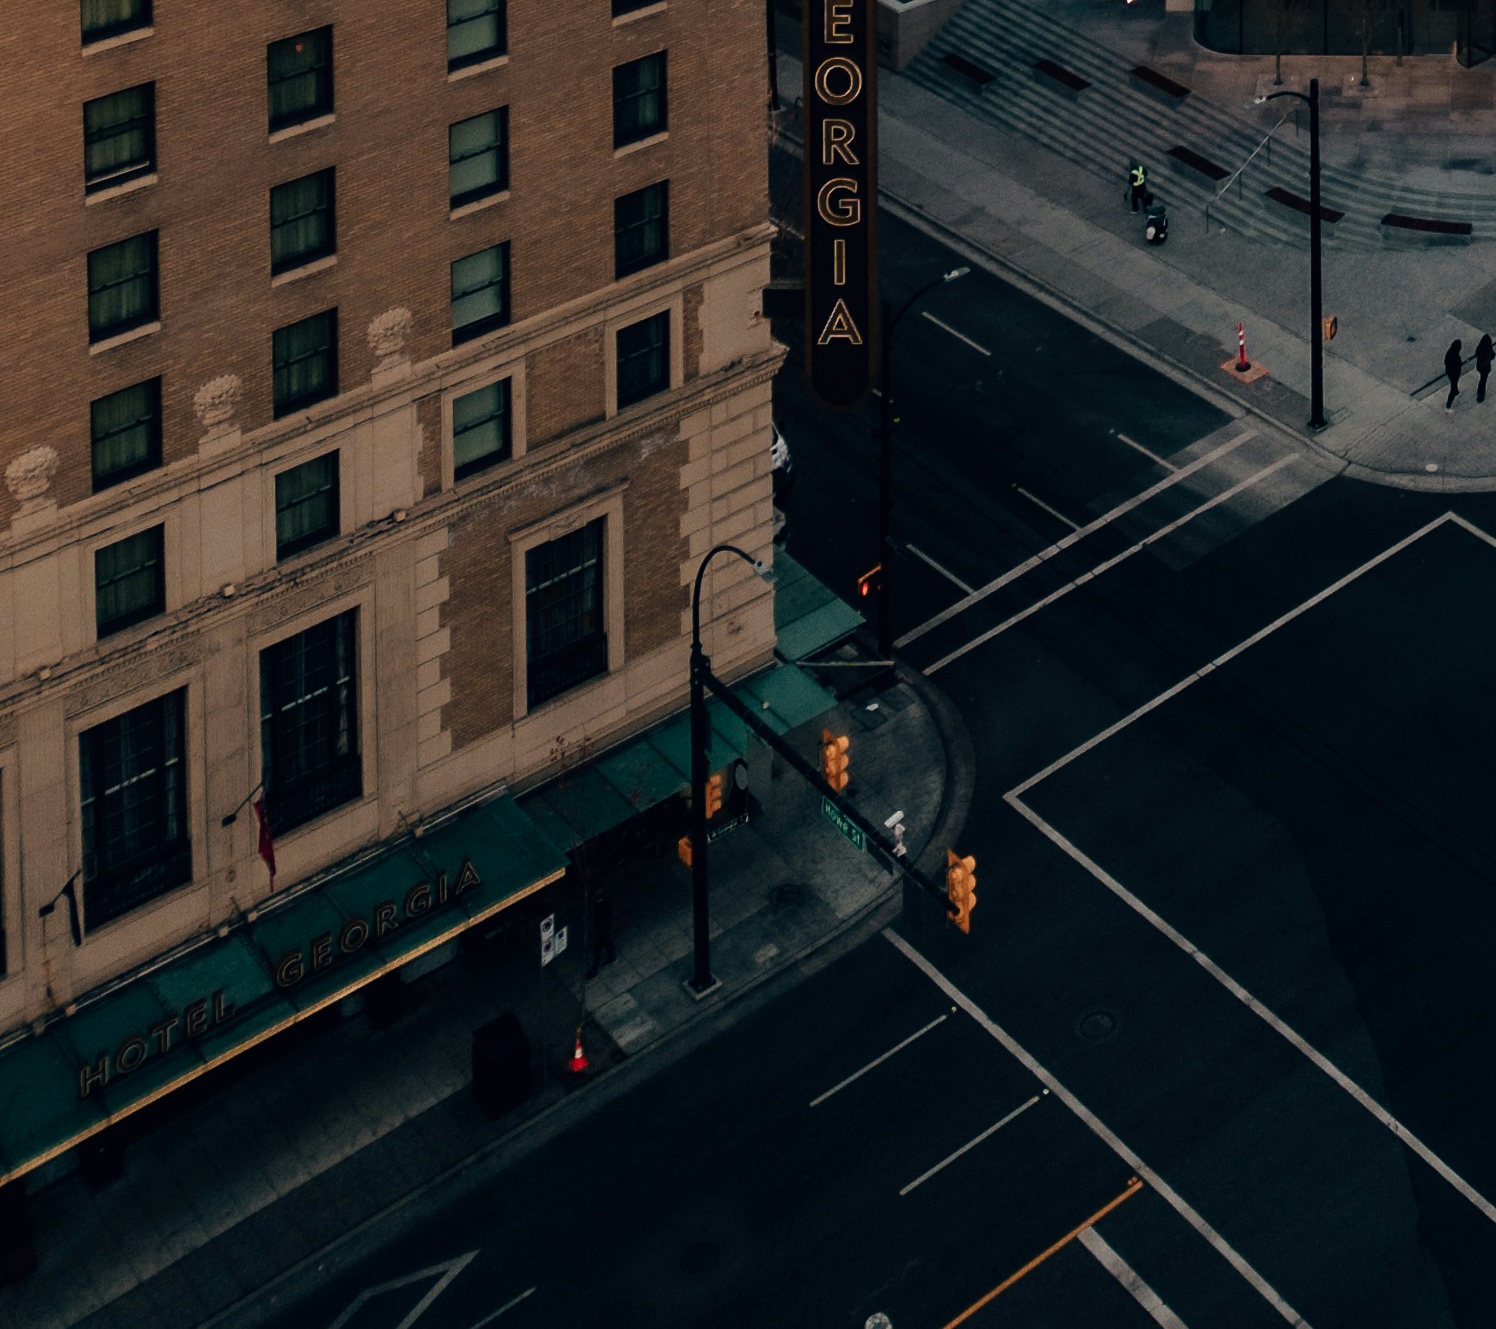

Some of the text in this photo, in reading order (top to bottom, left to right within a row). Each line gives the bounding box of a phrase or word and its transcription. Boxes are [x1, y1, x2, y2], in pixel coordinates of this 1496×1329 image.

[825, 804, 861, 844] Howe St
[79, 987, 237, 1099] HOTEL
[275, 859, 483, 989] GEORGIA
